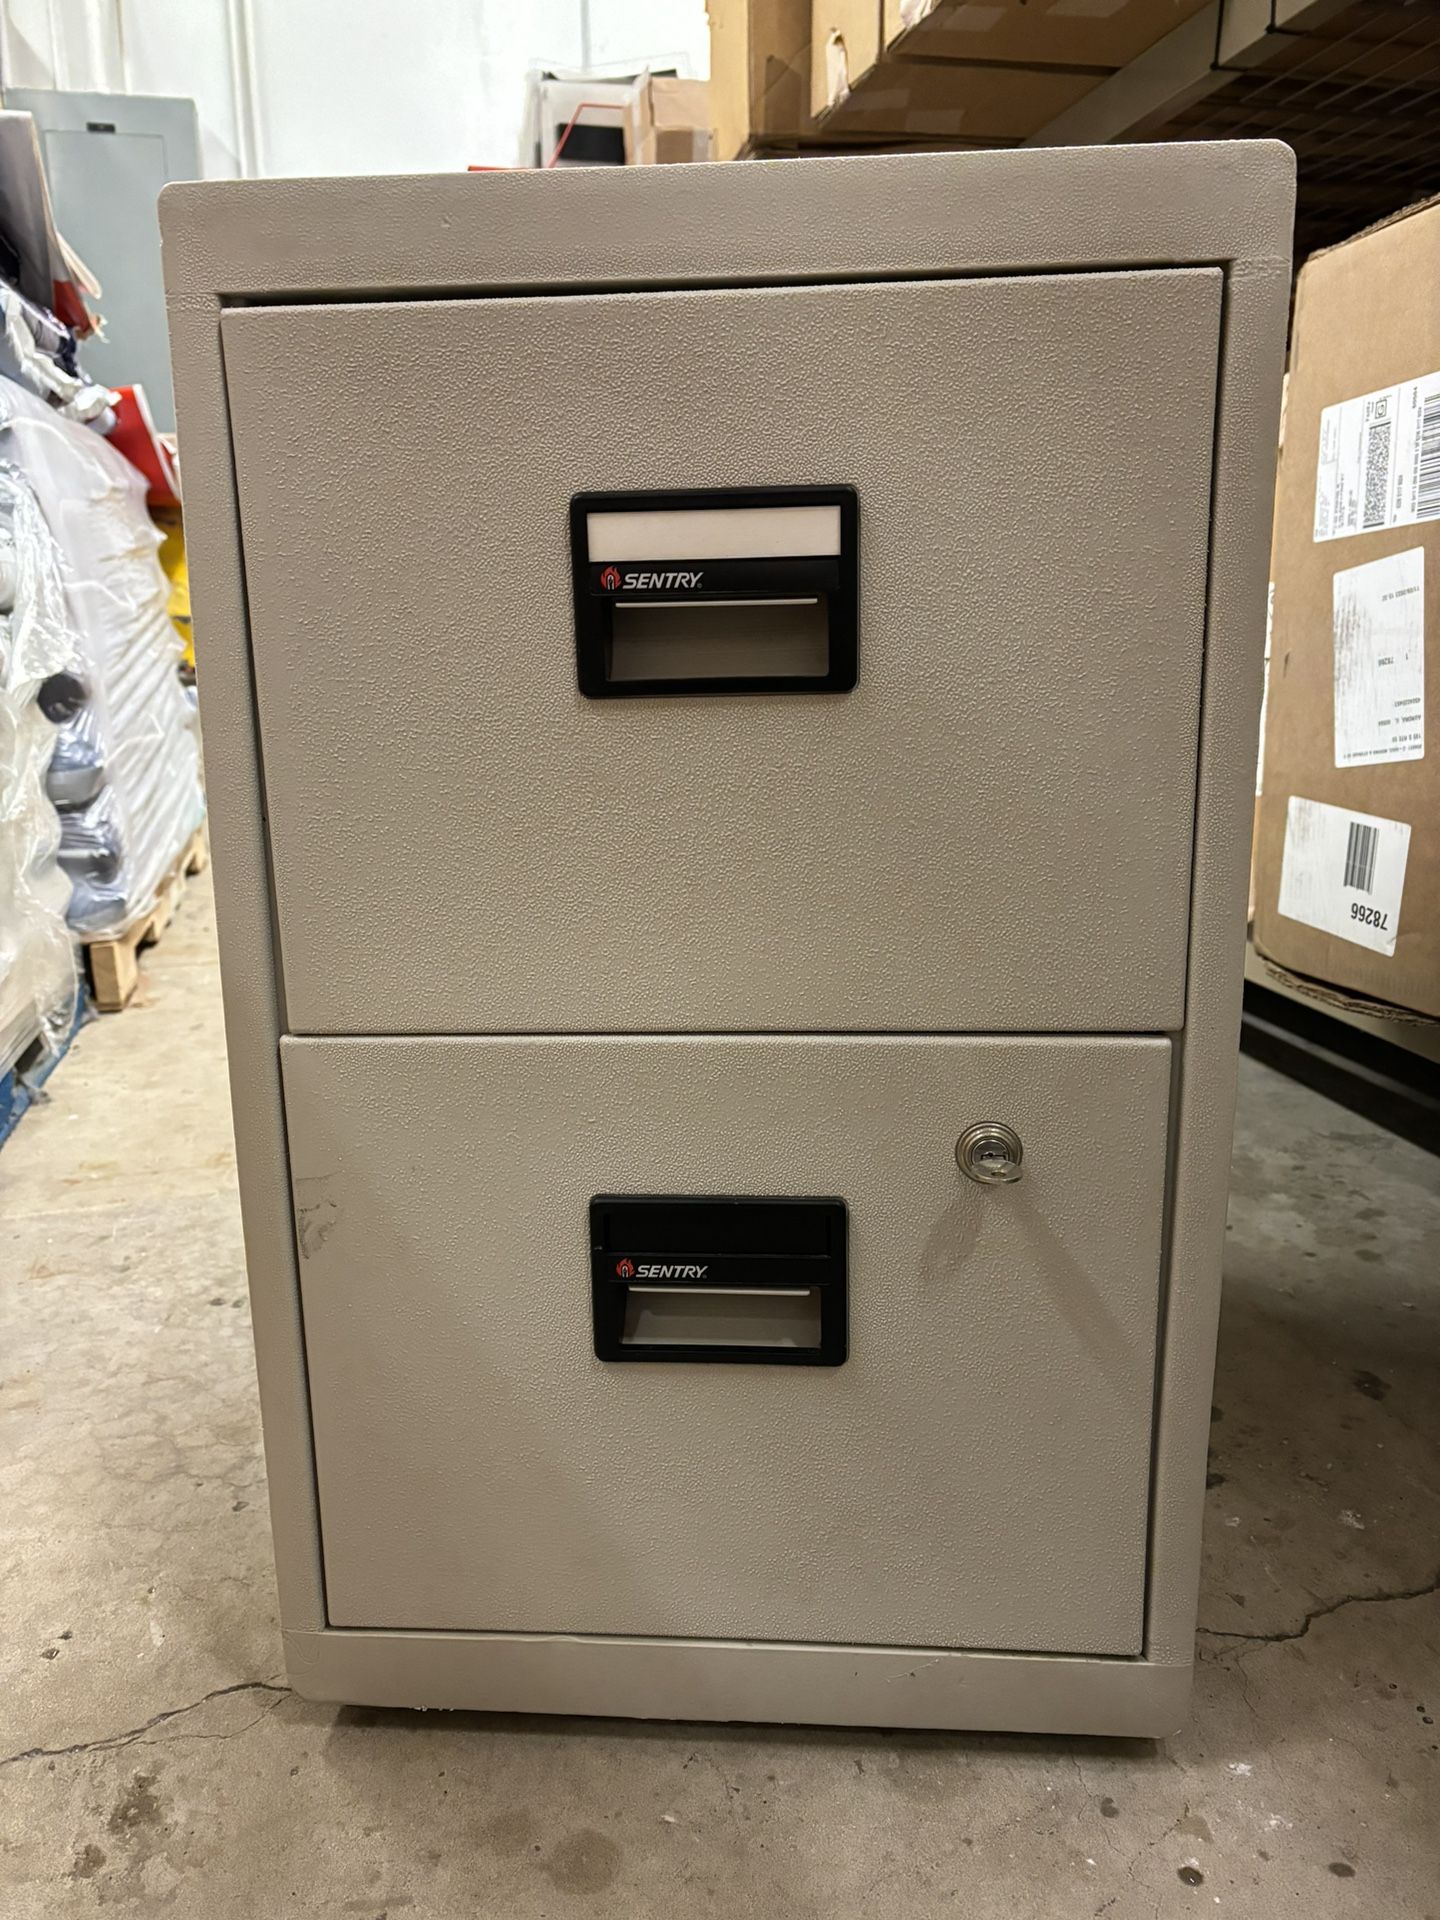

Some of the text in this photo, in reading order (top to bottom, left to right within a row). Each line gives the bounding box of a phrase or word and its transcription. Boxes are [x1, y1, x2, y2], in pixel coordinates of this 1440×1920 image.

[622, 571, 704, 589] SENTRY
[1350, 902, 1388, 931] 78266
[635, 1265, 708, 1278] SENTRY
